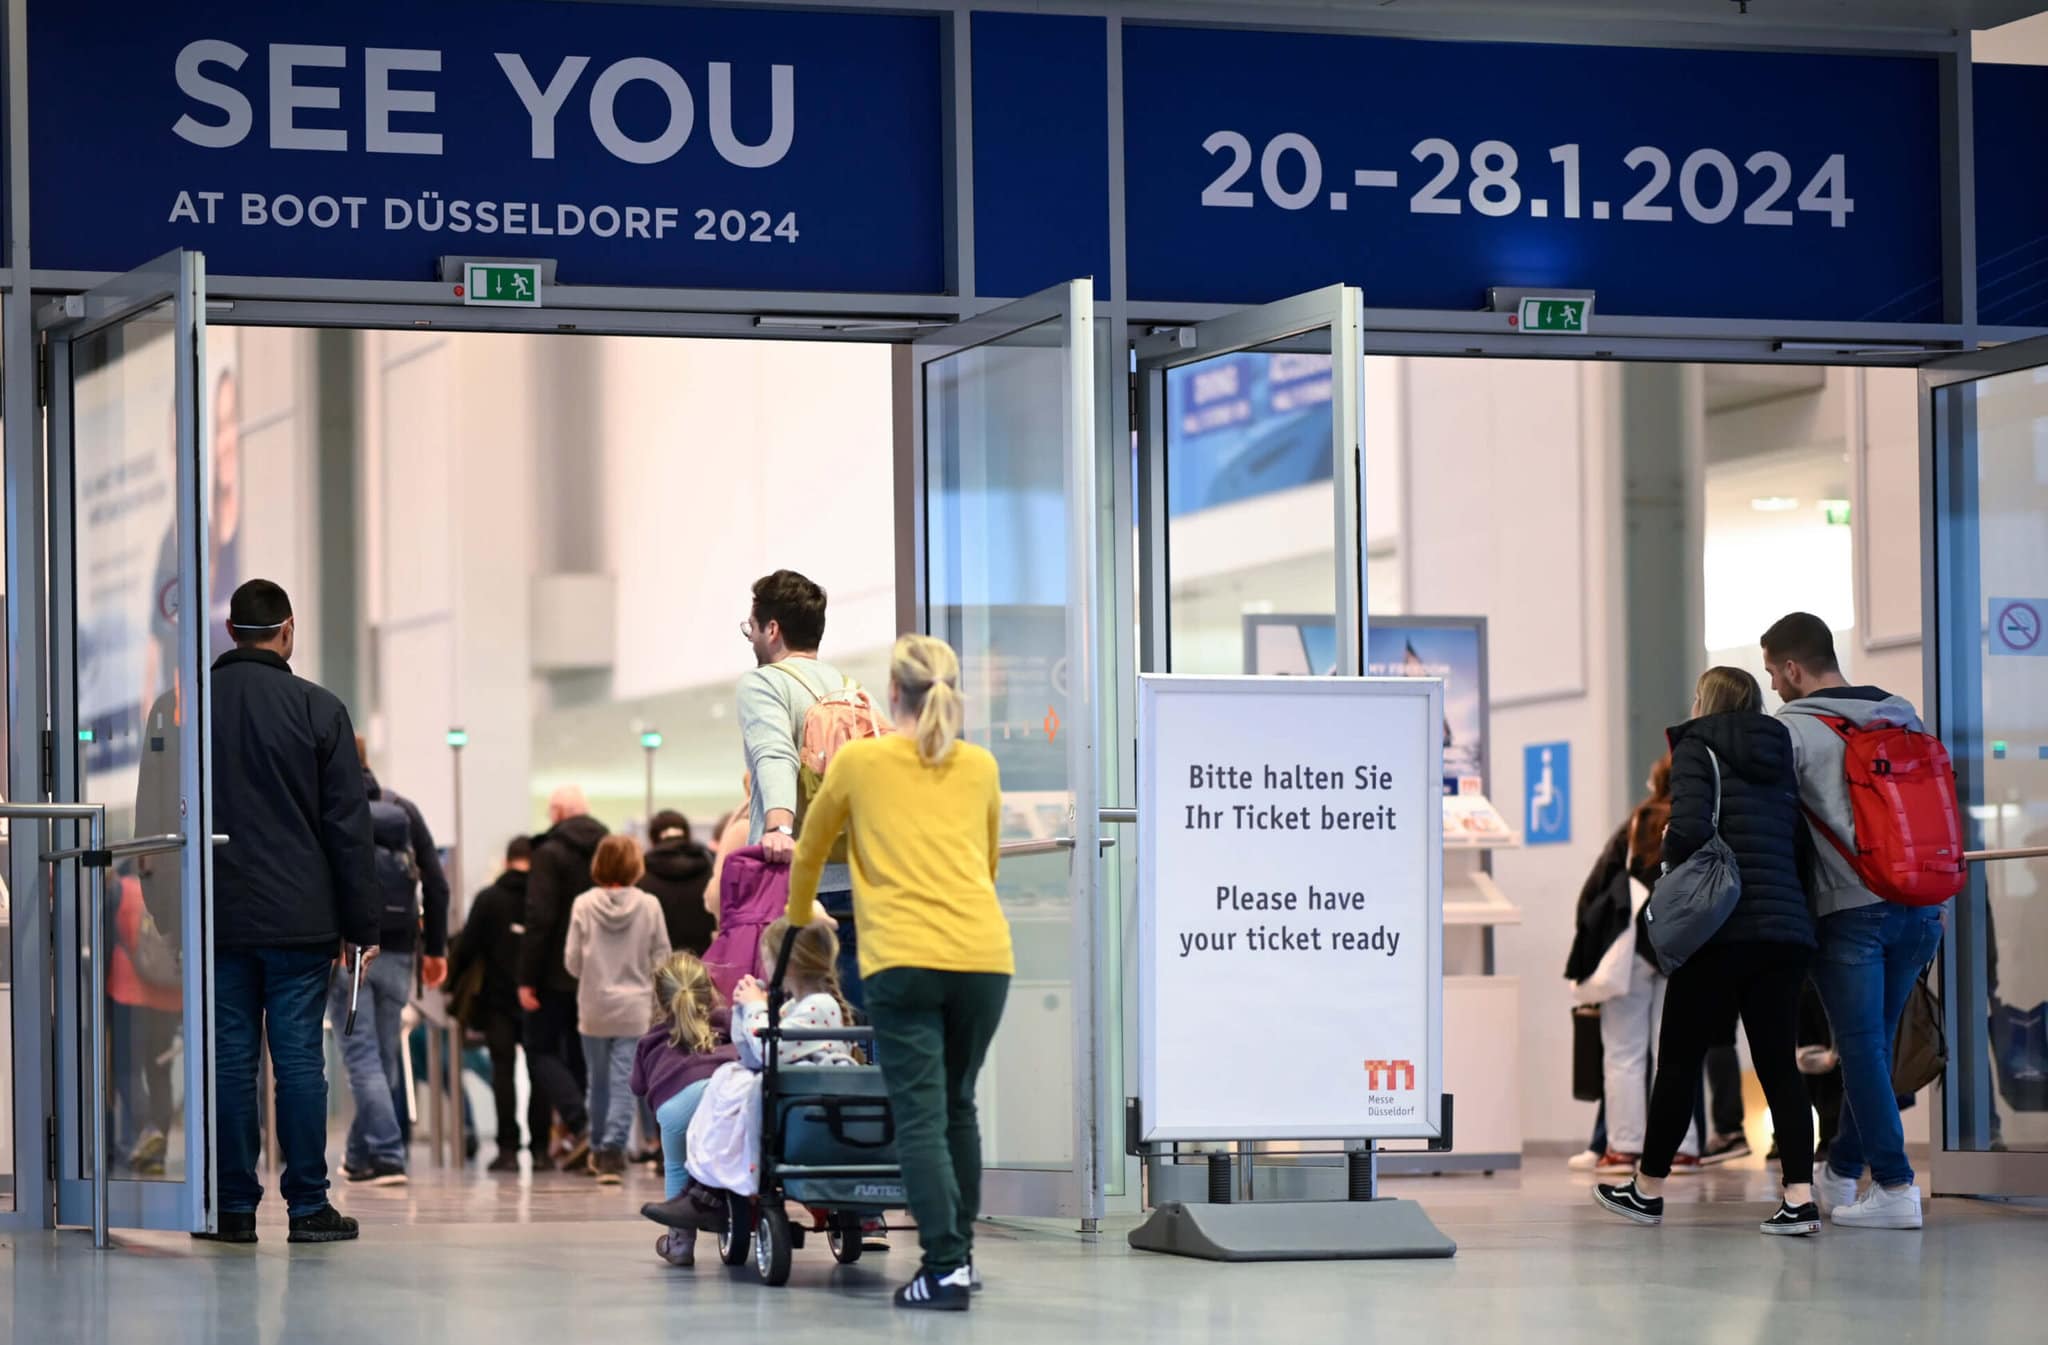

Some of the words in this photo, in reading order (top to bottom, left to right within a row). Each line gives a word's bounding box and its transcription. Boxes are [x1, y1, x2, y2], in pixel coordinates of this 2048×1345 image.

[172, 40, 442, 155] SEE
[495, 53, 794, 167] YOU
[169, 191, 223, 223] AT
[242, 194, 367, 229] BOOT
[385, 192, 678, 239] DÜSSELDORF
[695, 209, 799, 243] 2024
[1189, 764, 1253, 790] Bitte
[1264, 764, 1344, 790] halten
[1355, 764, 1393, 790] Sie
[1185, 804, 1224, 830] Ihr
[1232, 804, 1311, 830] Ticket
[1321, 804, 1397, 831] bereit
[1217, 885, 1298, 911] Please
[1308, 885, 1365, 911] have
[1180, 931, 1237, 957] your
[1246, 925, 1322, 951] ticket
[1332, 925, 1400, 957] ready
[1368, 1095, 1395, 1105] Messe
[1368, 1106, 1415, 1117] Düsseldorf
